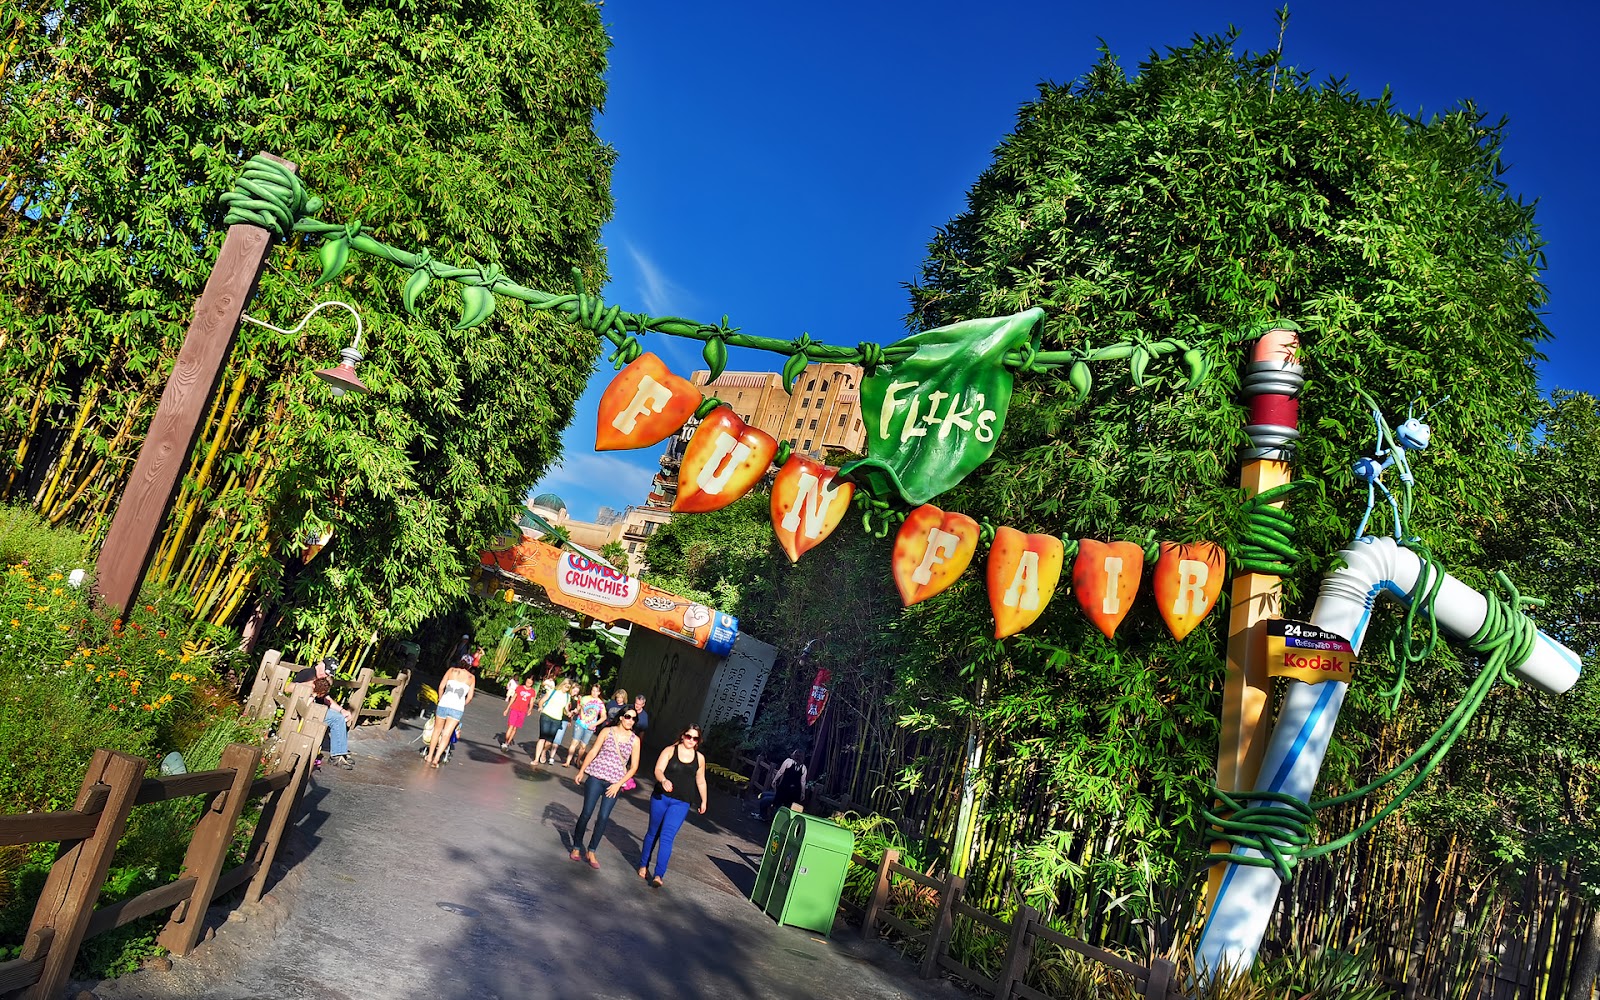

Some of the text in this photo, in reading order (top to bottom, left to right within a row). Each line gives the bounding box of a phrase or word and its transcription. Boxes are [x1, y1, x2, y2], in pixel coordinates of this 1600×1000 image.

[565, 570, 629, 598] CRUNCHIES
[911, 527, 1209, 616] FAIR
[1284, 624, 1302, 637] 24
[1319, 632, 1337, 640] FILM
[1284, 652, 1344, 673] Kodak
[719, 683, 733, 704] Very
[723, 667, 746, 723] Coupon bec
[731, 689, 748, 718] Clip th
[743, 673, 764, 723] SPECIAL CO
[713, 704, 725, 725] Spec
